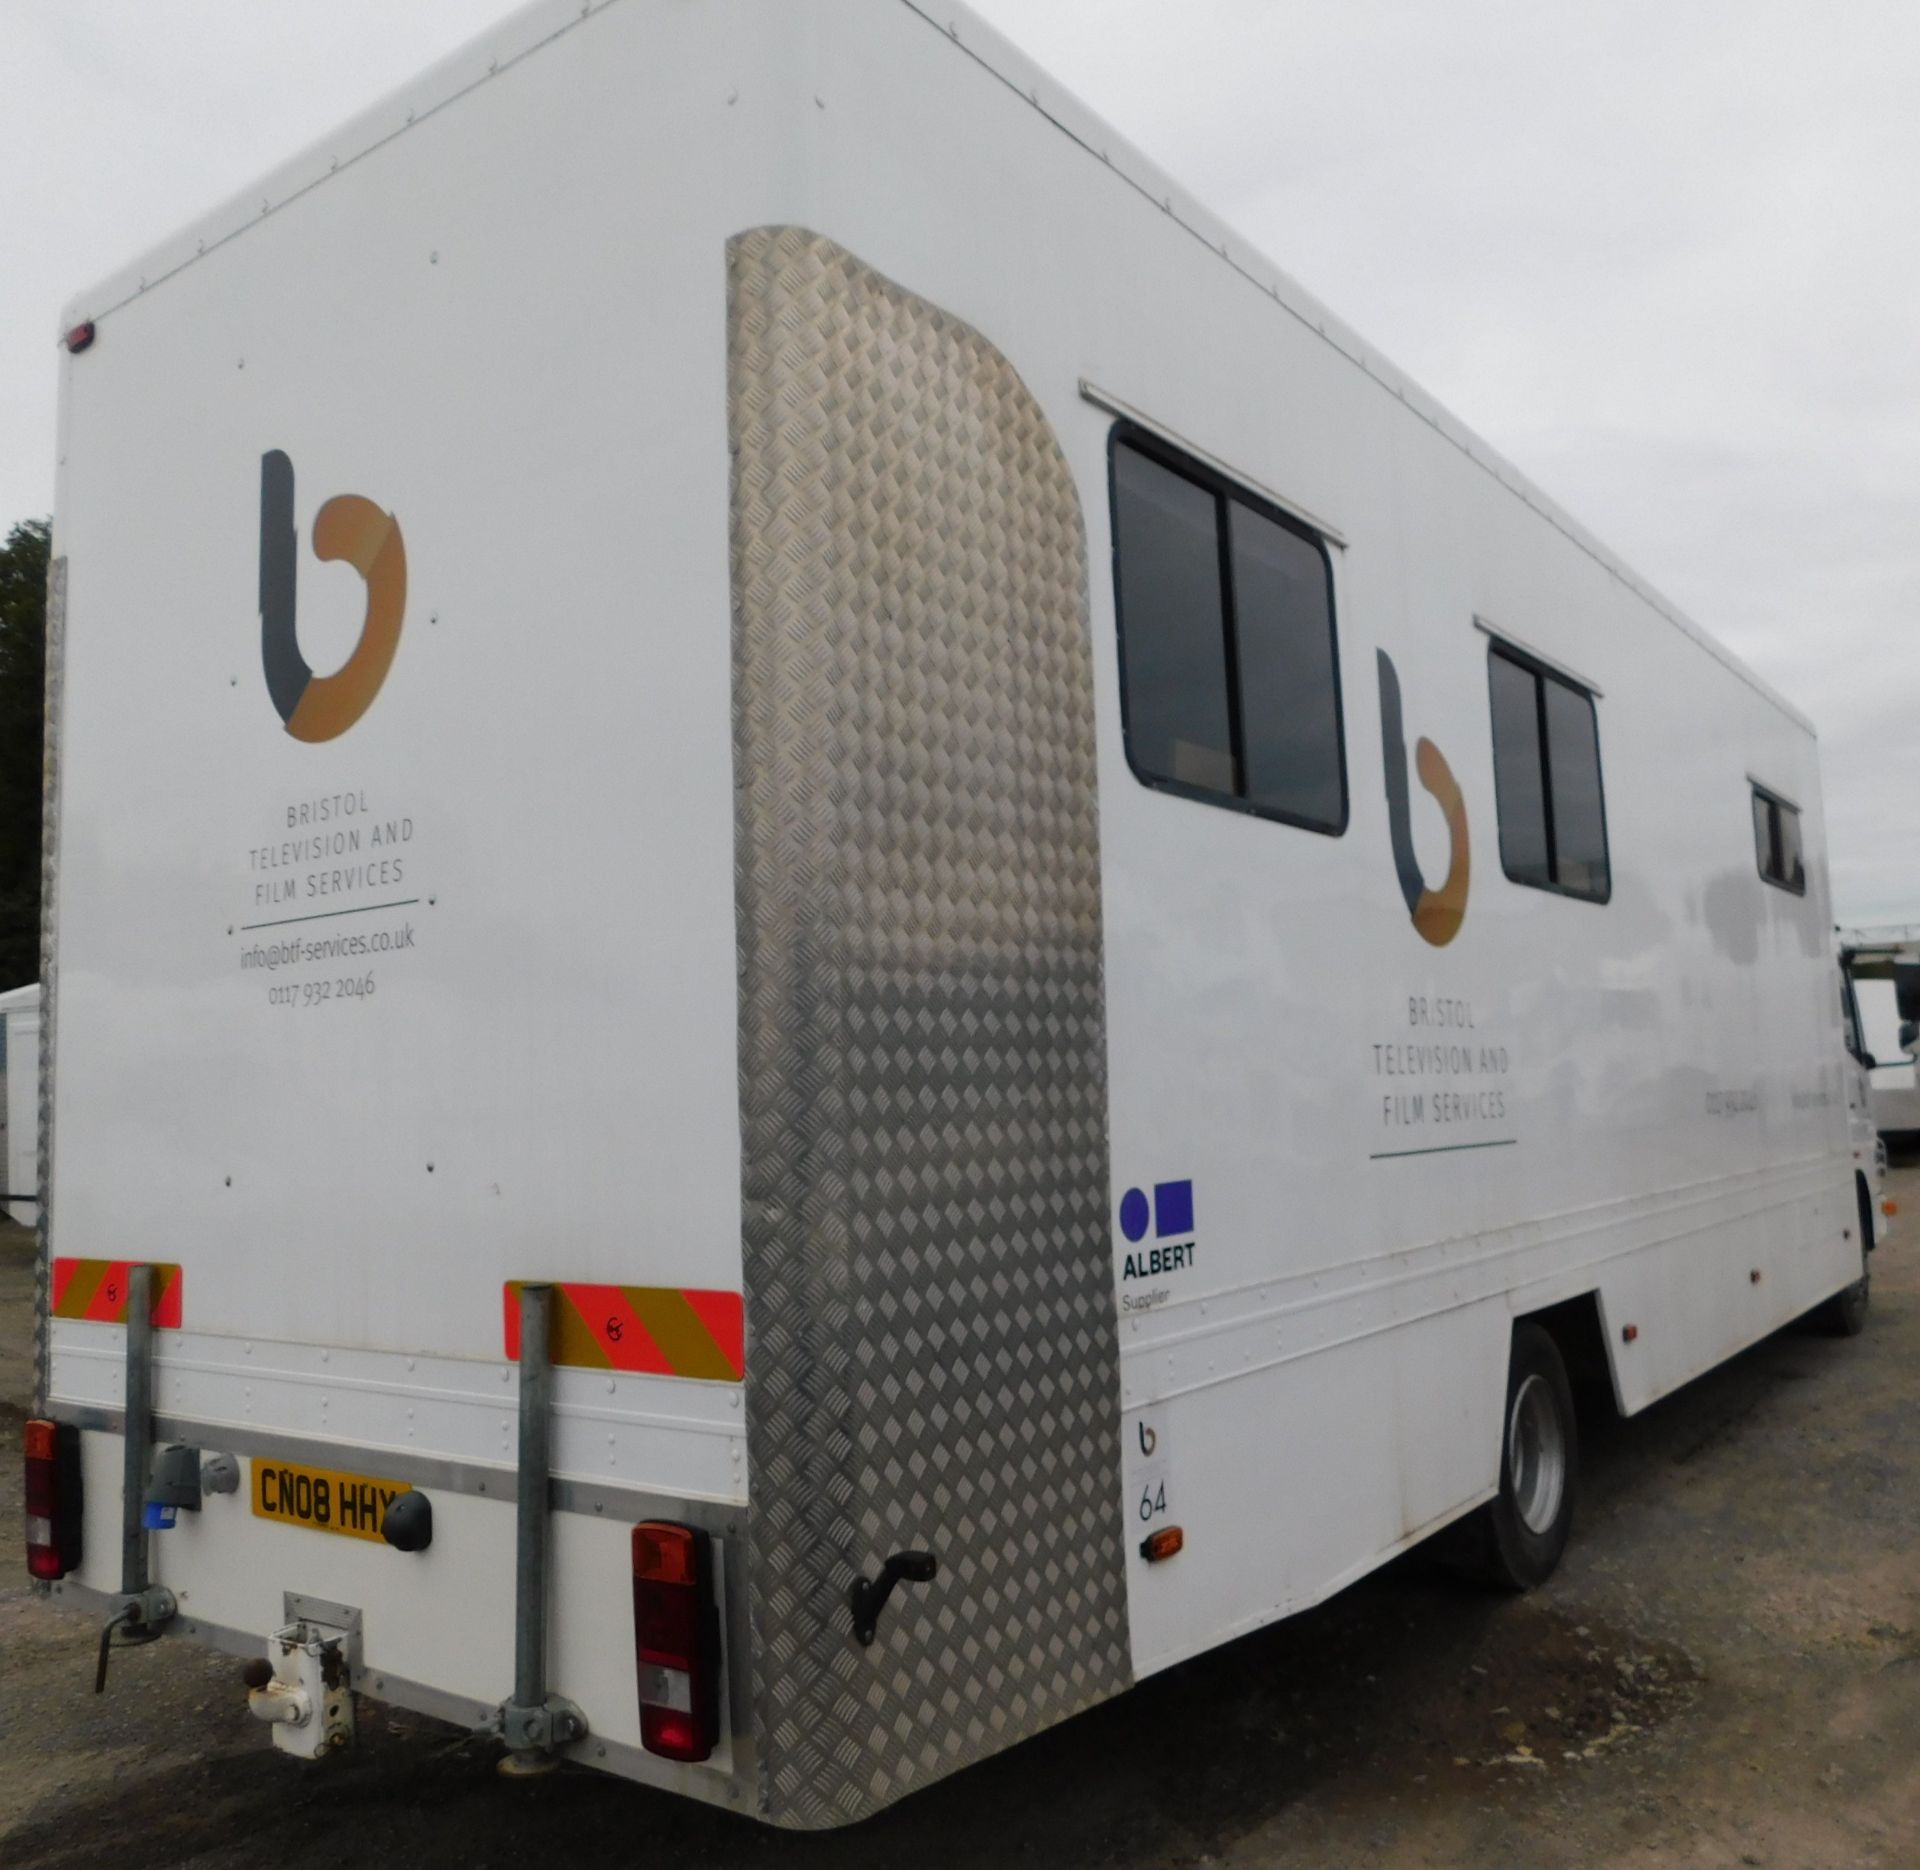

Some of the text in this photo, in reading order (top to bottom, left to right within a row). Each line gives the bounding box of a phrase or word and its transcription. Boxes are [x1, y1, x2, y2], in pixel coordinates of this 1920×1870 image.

[287, 789, 368, 828] BRISTOL
[249, 818, 413, 871] TELEVISION AND
[255, 859, 403, 905] FILM SERVICES
[240, 921, 415, 971] info@btf-services.co.uk
[269, 970, 375, 1007] 0117 932 2046
[1409, 996, 1475, 1029] BRISTOL
[1372, 1044, 1508, 1075] TELEVISION AND
[1384, 1091, 1505, 1126] FILM SERVICES
[1123, 1242, 1195, 1281] ALBERT
[1123, 1287, 1170, 1311] Supplier
[261, 1468, 331, 1523] CN08
[1139, 1479, 1166, 1521] 64
